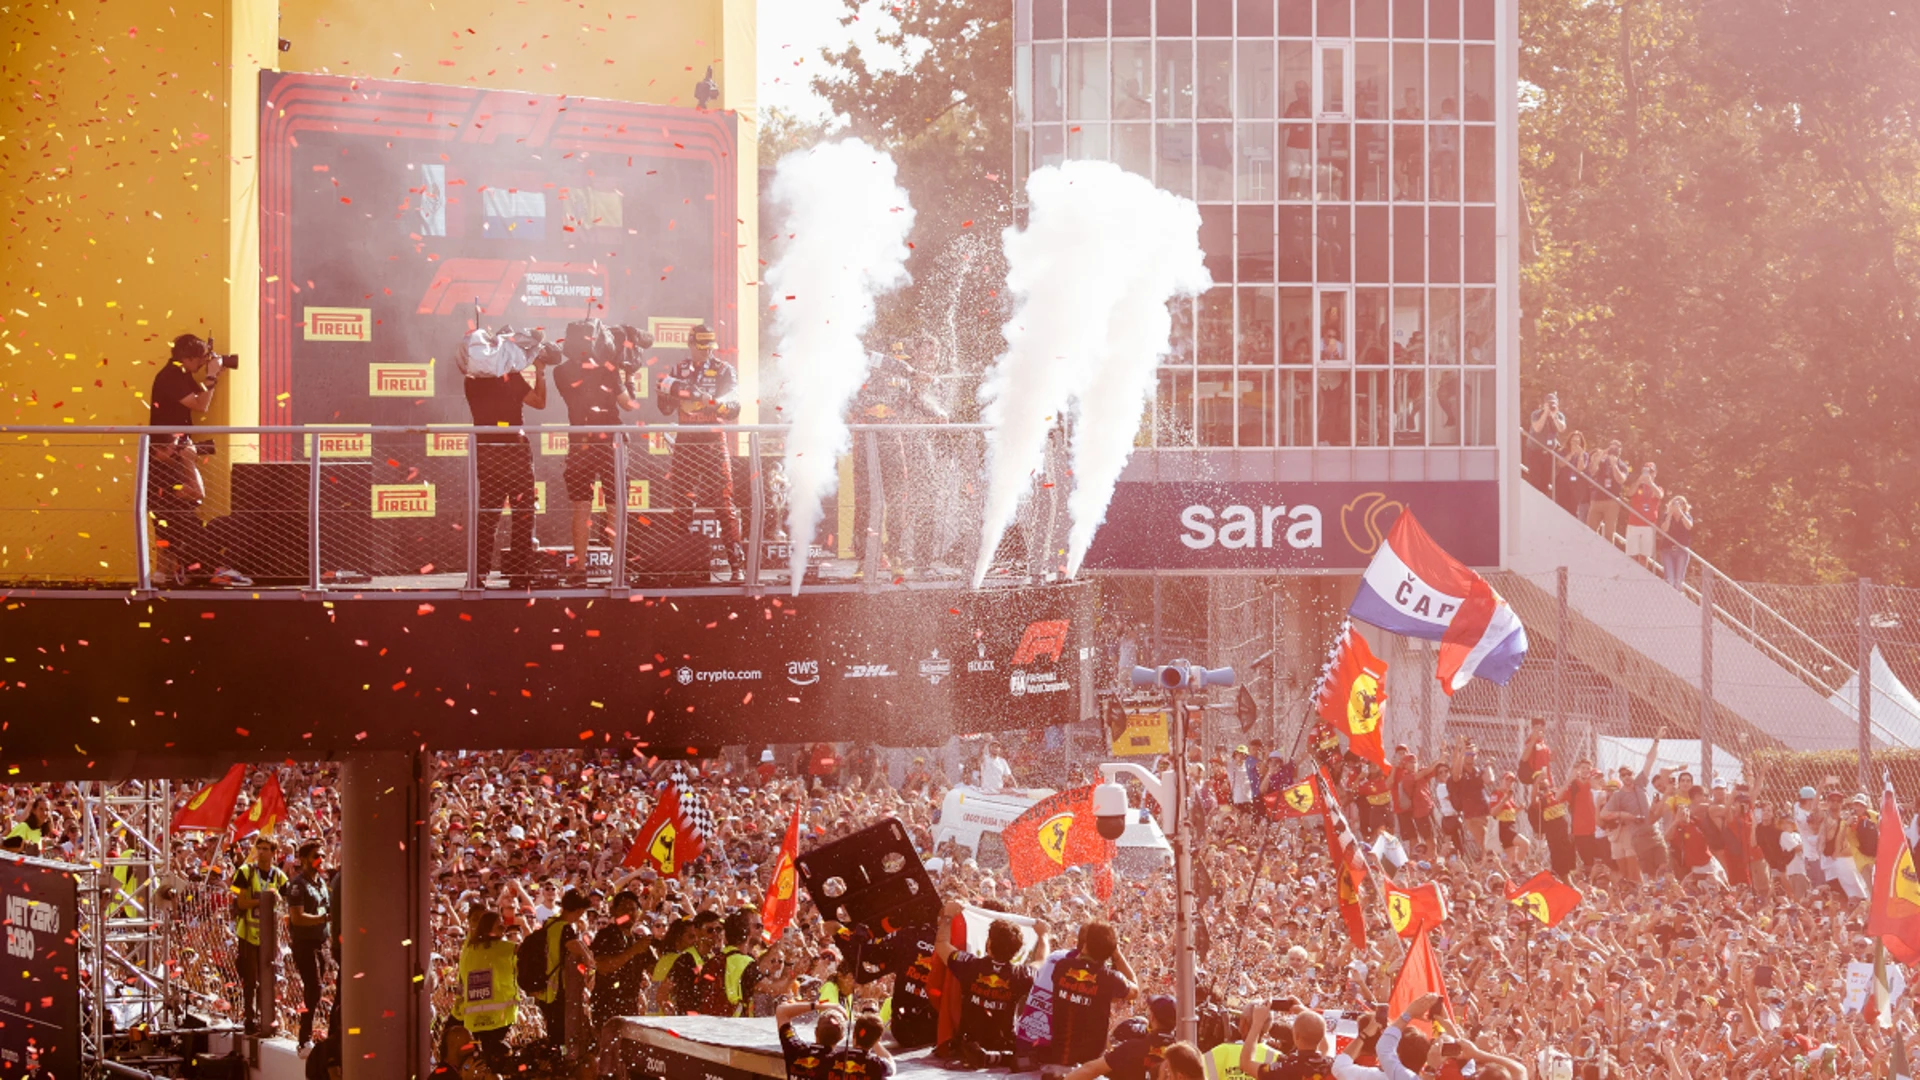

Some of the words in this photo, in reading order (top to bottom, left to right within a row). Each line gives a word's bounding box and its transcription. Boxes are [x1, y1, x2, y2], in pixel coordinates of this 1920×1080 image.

[312, 313, 363, 335] PIRELLI
[377, 369, 427, 391] PIRELLI
[378, 490, 428, 511] PIRELLI
[1180, 504, 1322, 549] sara
[696, 669, 762, 682] crypto.com
[788, 660, 819, 674] aws
[851, 664, 890, 677] DHL
[6, 894, 29, 927] NET
[28, 900, 60, 935] ZERO
[6, 926, 35, 960] 2030
